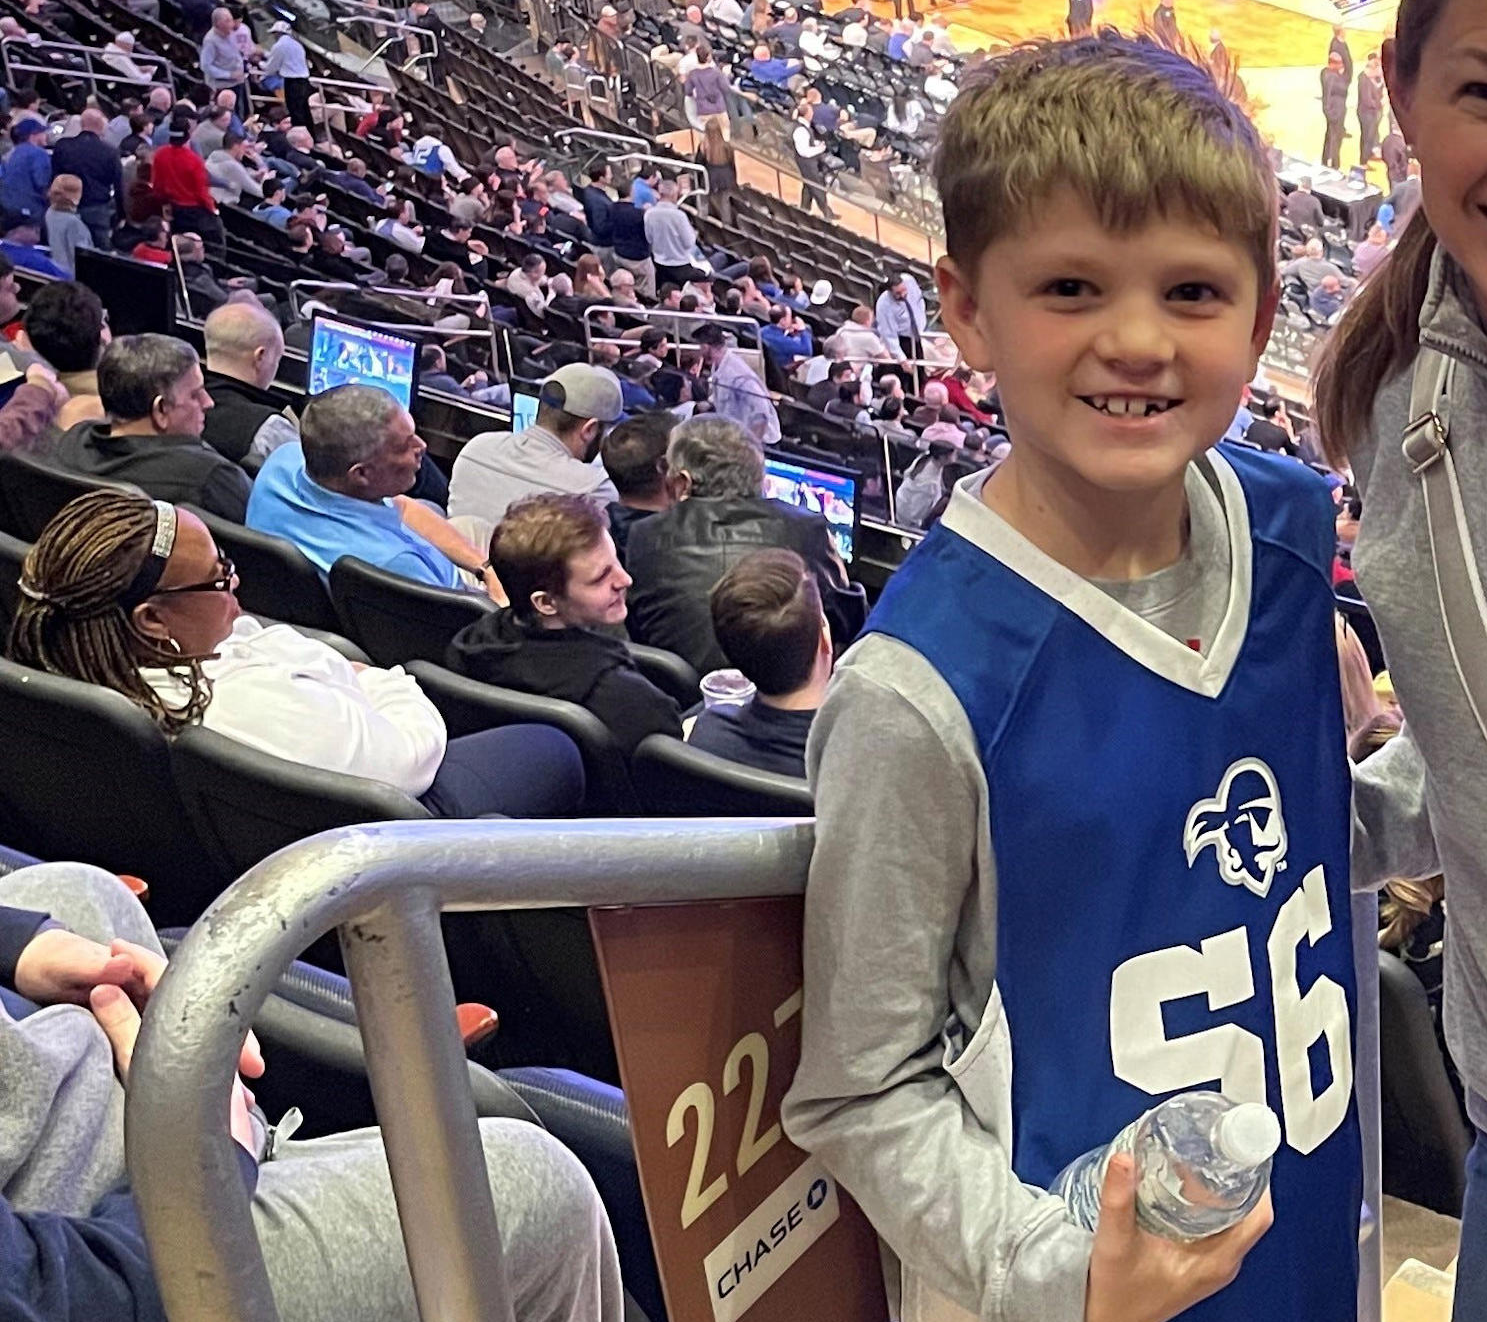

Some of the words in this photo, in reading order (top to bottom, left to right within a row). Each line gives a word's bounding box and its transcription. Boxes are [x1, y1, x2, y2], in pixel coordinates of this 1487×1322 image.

[666, 989, 803, 1230] 22
[1109, 864, 1354, 1156] 56
[717, 1200, 806, 1300] CHASE
